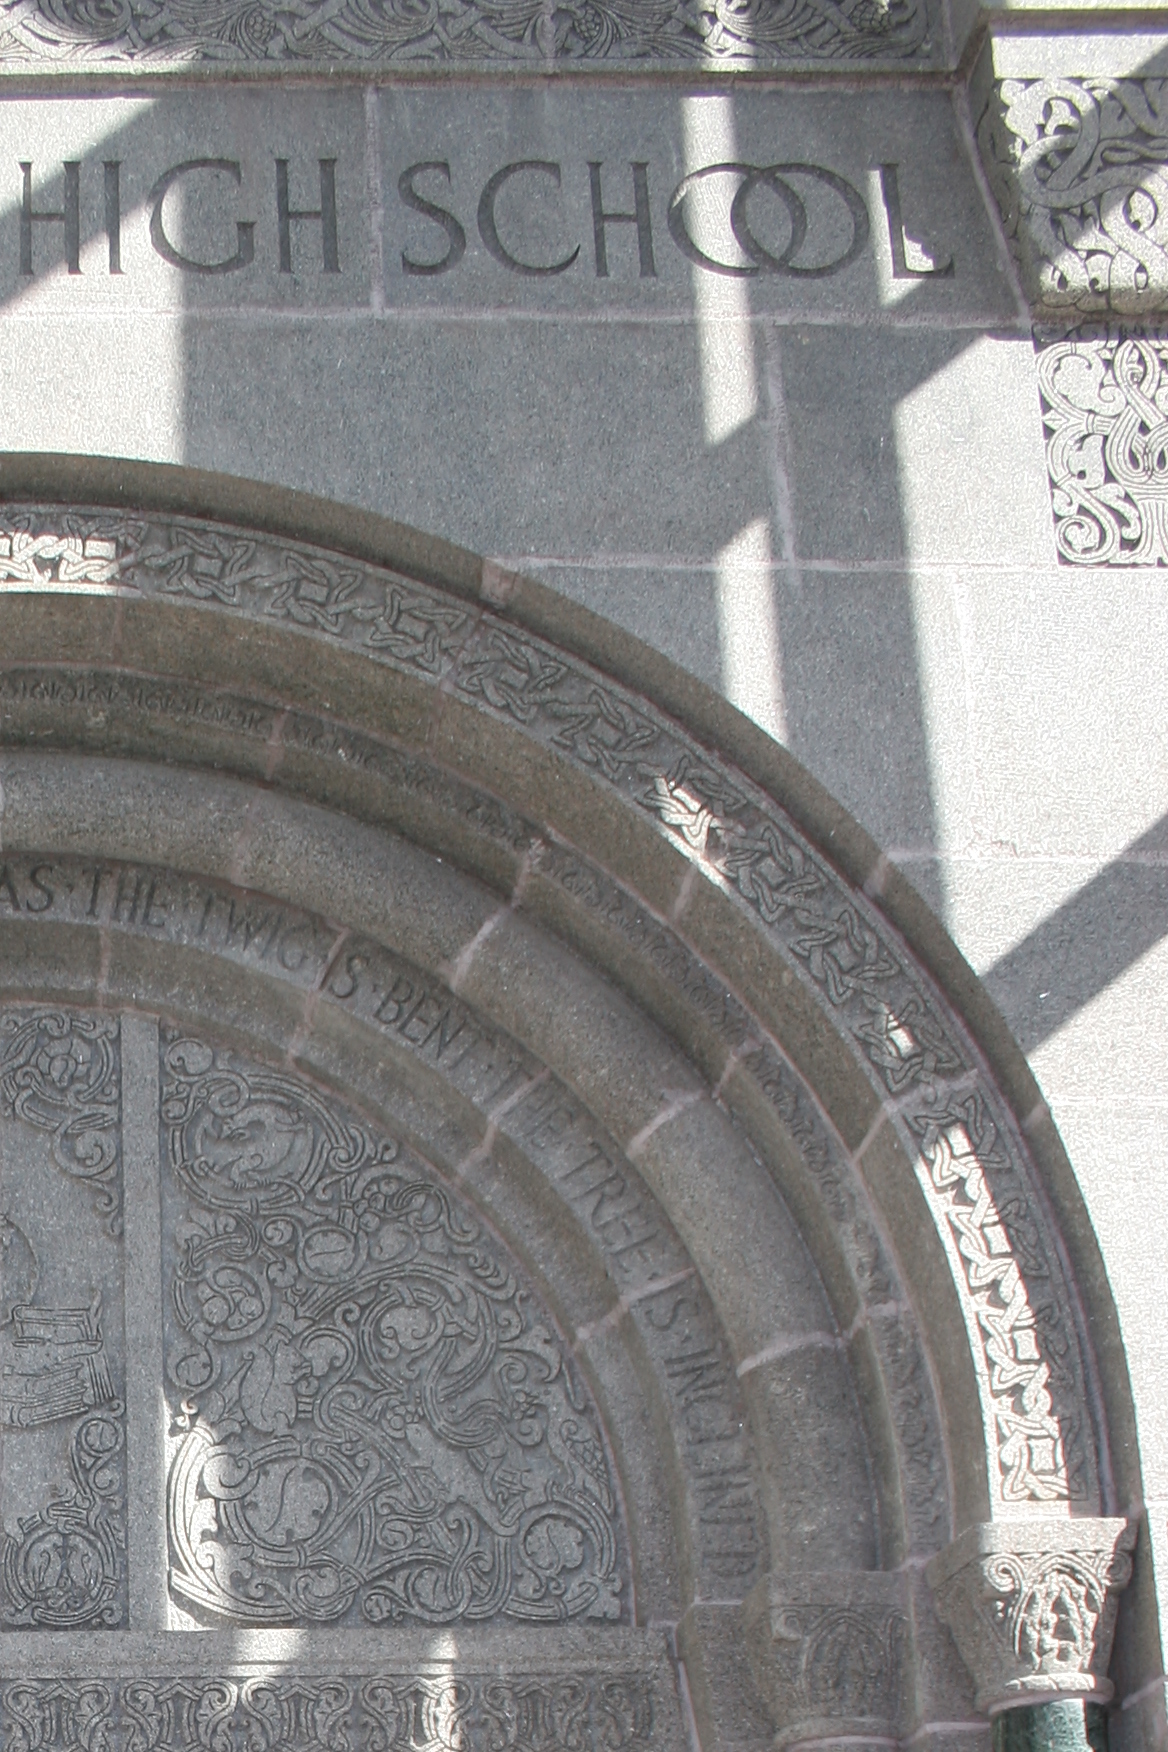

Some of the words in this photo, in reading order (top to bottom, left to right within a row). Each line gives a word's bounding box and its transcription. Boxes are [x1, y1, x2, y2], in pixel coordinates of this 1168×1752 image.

[18, 156, 344, 278] HIGH
[395, 157, 956, 281] SCHOOL
[82, 867, 170, 928] THE
[189, 890, 319, 972] TWIG
[373, 974, 497, 1071] BENT
[559, 1141, 670, 1273] TREE
[663, 1341, 761, 1578] INCLINED
